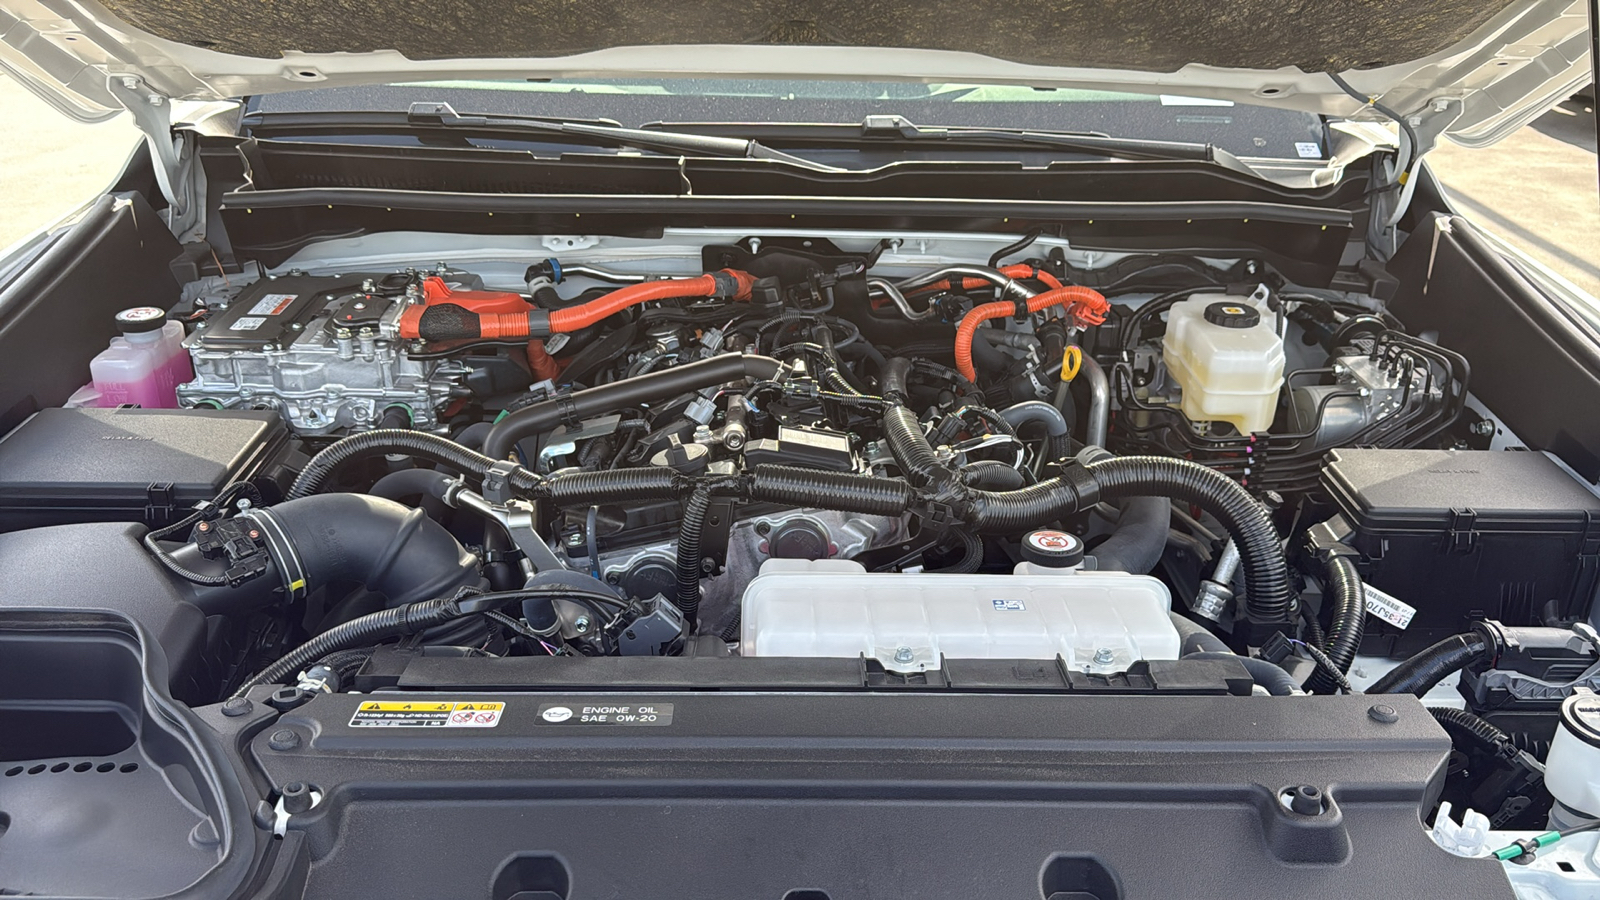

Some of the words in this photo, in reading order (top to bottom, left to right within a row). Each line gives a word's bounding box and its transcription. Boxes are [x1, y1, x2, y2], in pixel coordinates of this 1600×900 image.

[582, 706, 630, 714] ENGINE
[638, 706, 659, 714] OIL
[580, 714, 608, 722] SAE
[616, 714, 657, 722] 0W-20
